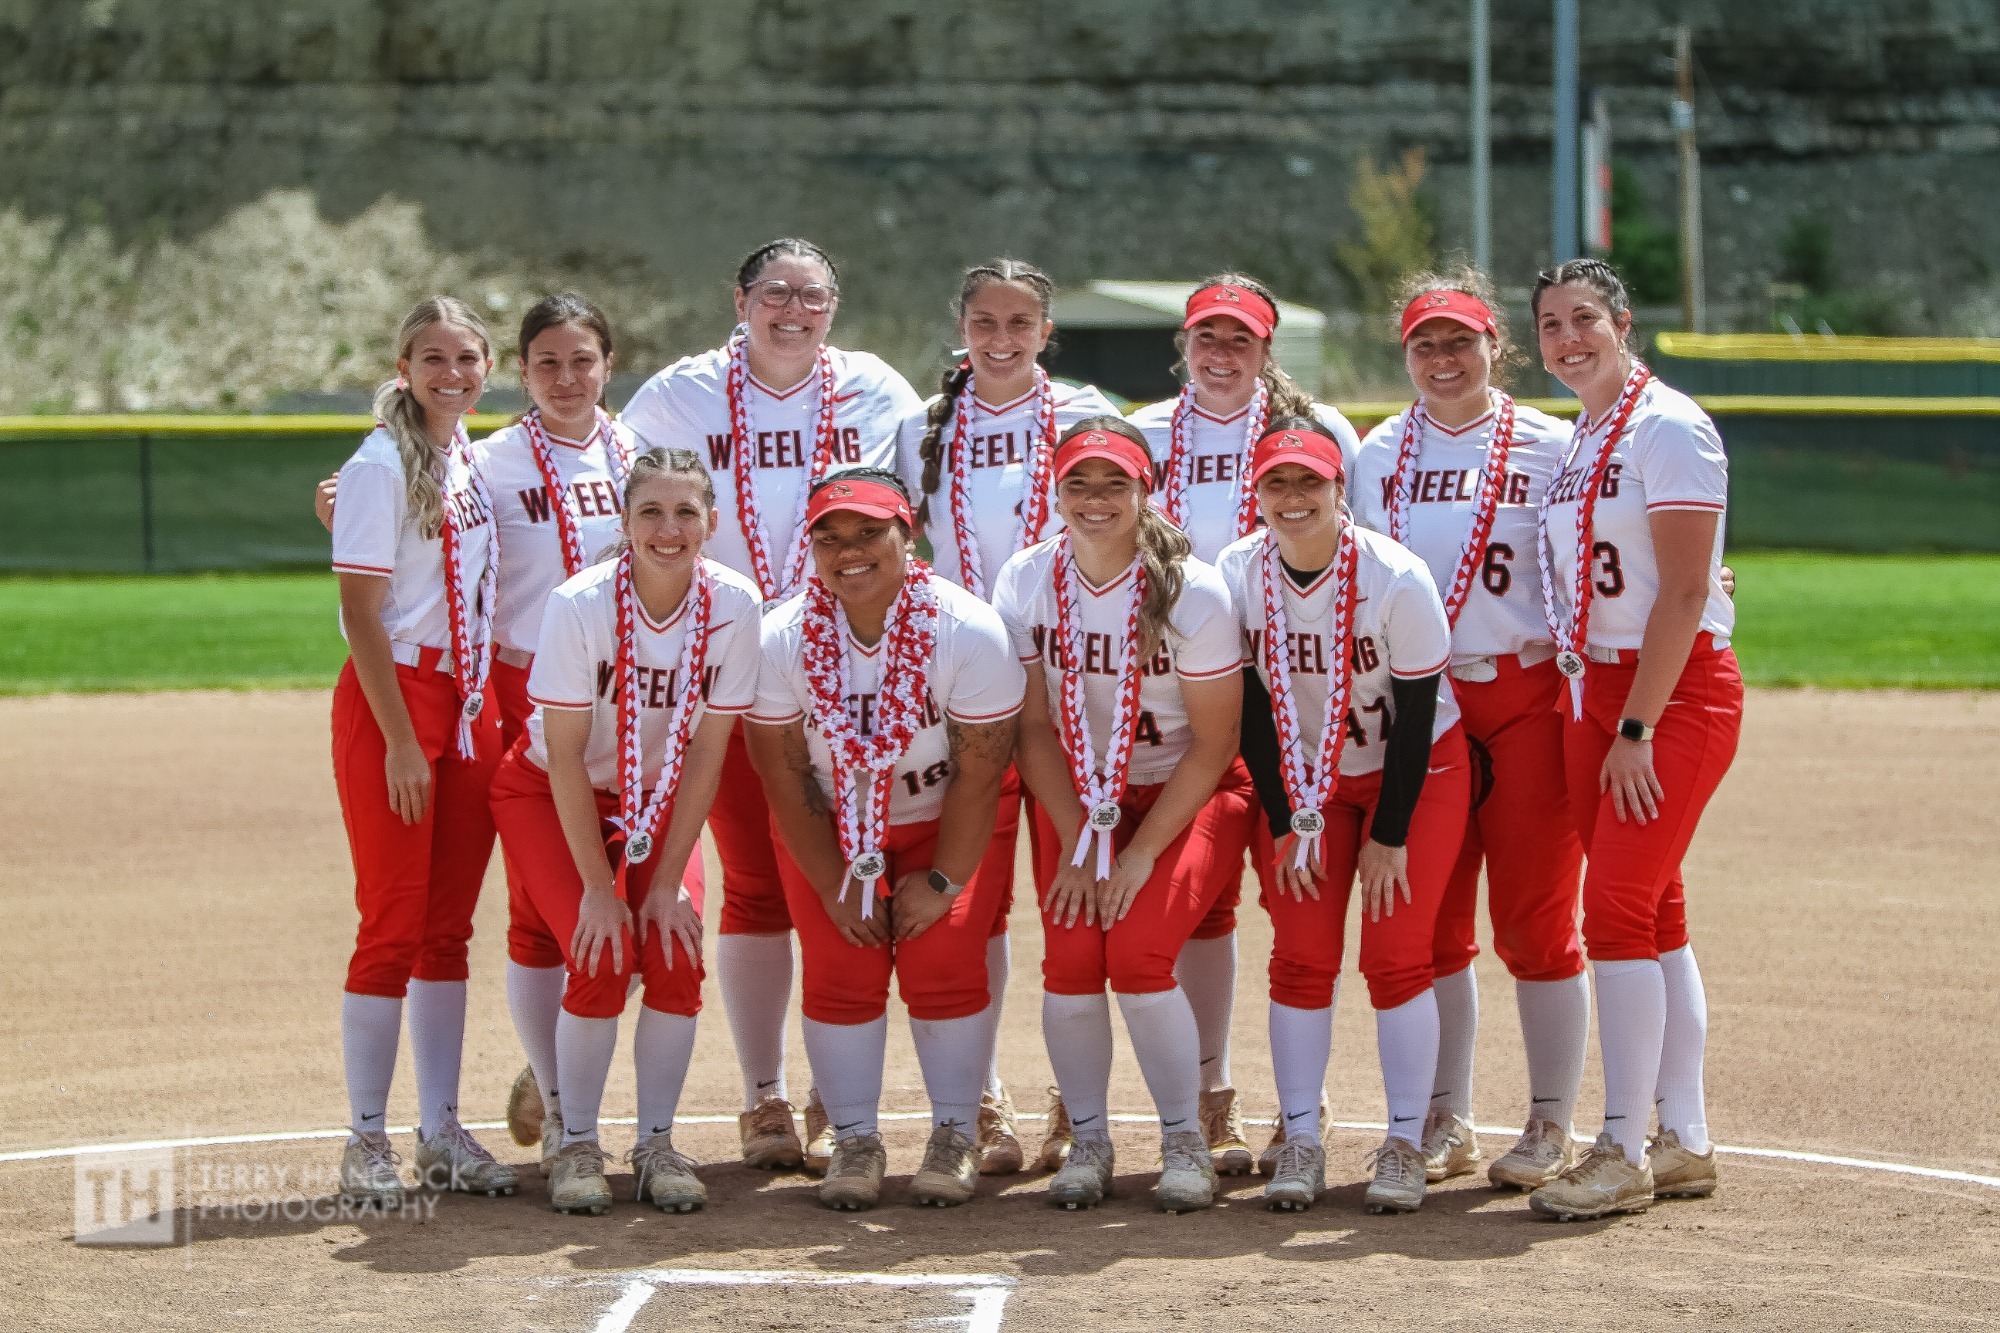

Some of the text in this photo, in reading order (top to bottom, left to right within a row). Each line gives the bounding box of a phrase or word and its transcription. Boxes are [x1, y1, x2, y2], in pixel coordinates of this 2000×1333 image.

[1482, 541, 1515, 597] 6
[1592, 541, 1625, 598] 3
[1344, 696, 1392, 748] 47
